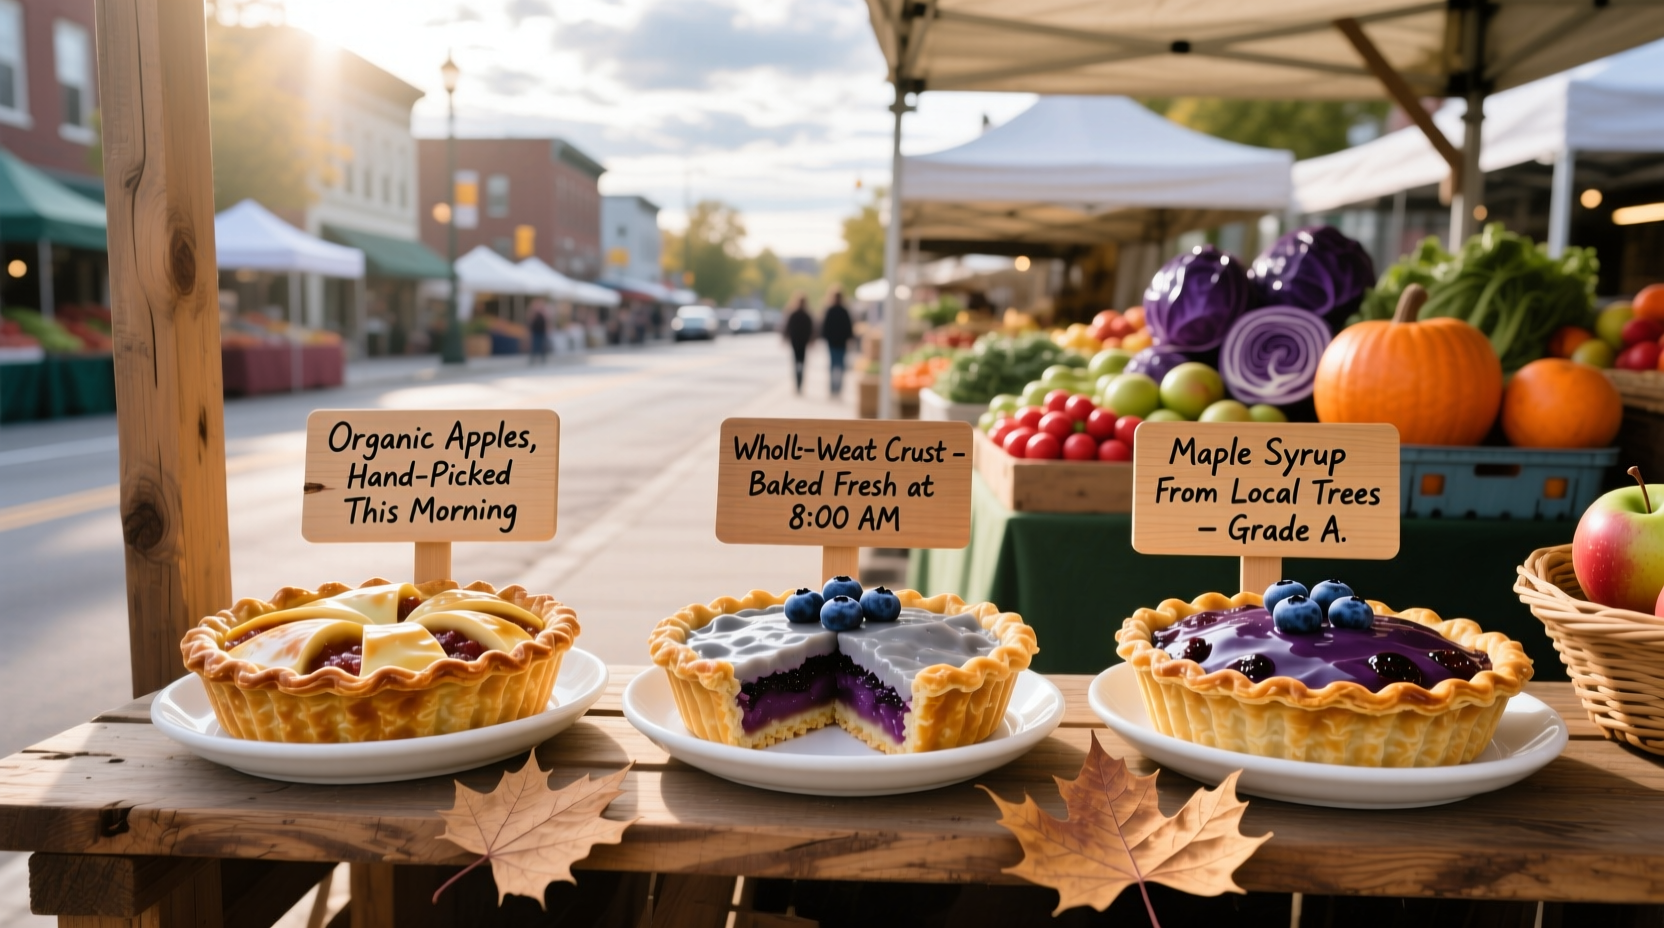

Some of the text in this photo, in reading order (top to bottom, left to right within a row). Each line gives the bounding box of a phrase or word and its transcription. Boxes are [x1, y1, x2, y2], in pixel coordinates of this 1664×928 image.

[328, 420, 537, 461] Organic Apples,
[884, 435, 948, 464] Crust
[1168, 436, 1347, 478] Maple Syrup
[347, 458, 513, 490] Hand-Picked
[748, 469, 935, 498] Baked Fresh at
[1155, 476, 1381, 506] From Local Trees
[343, 496, 518, 534] This Morning
[788, 503, 900, 532] 8:00 AM
[1228, 513, 1310, 545] Grade
[1320, 514, 1347, 544] A.
